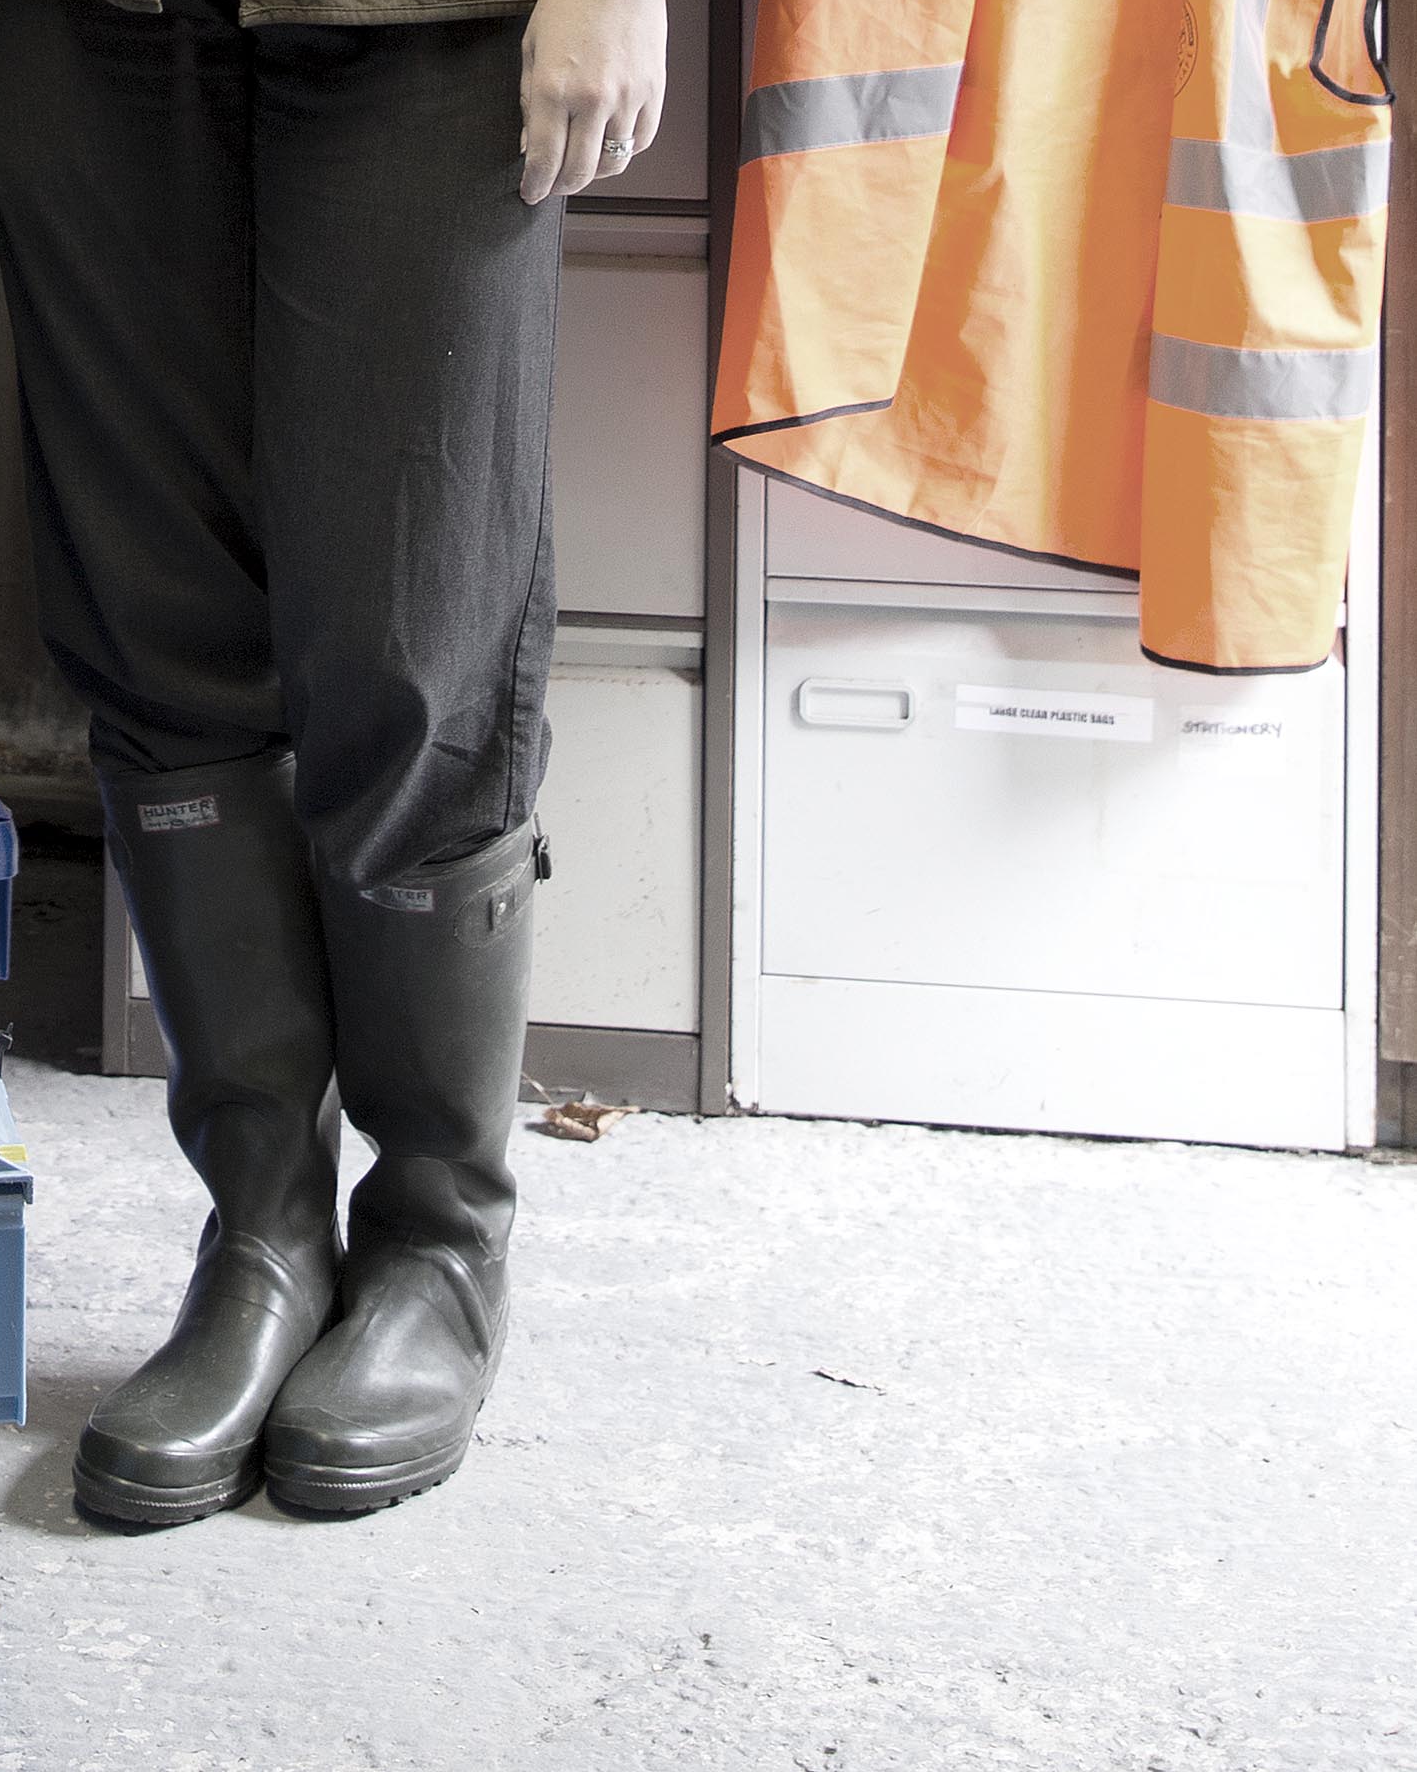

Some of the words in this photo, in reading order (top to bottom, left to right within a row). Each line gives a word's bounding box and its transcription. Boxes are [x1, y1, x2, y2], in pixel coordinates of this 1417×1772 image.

[1020, 708, 1048, 719] CLEAR
[1050, 710, 1088, 723] PLASTIC
[1090, 713, 1115, 725] BAGS
[1182, 719, 1282, 737] STATIONERY
[144, 799, 210, 817] HUNTER
